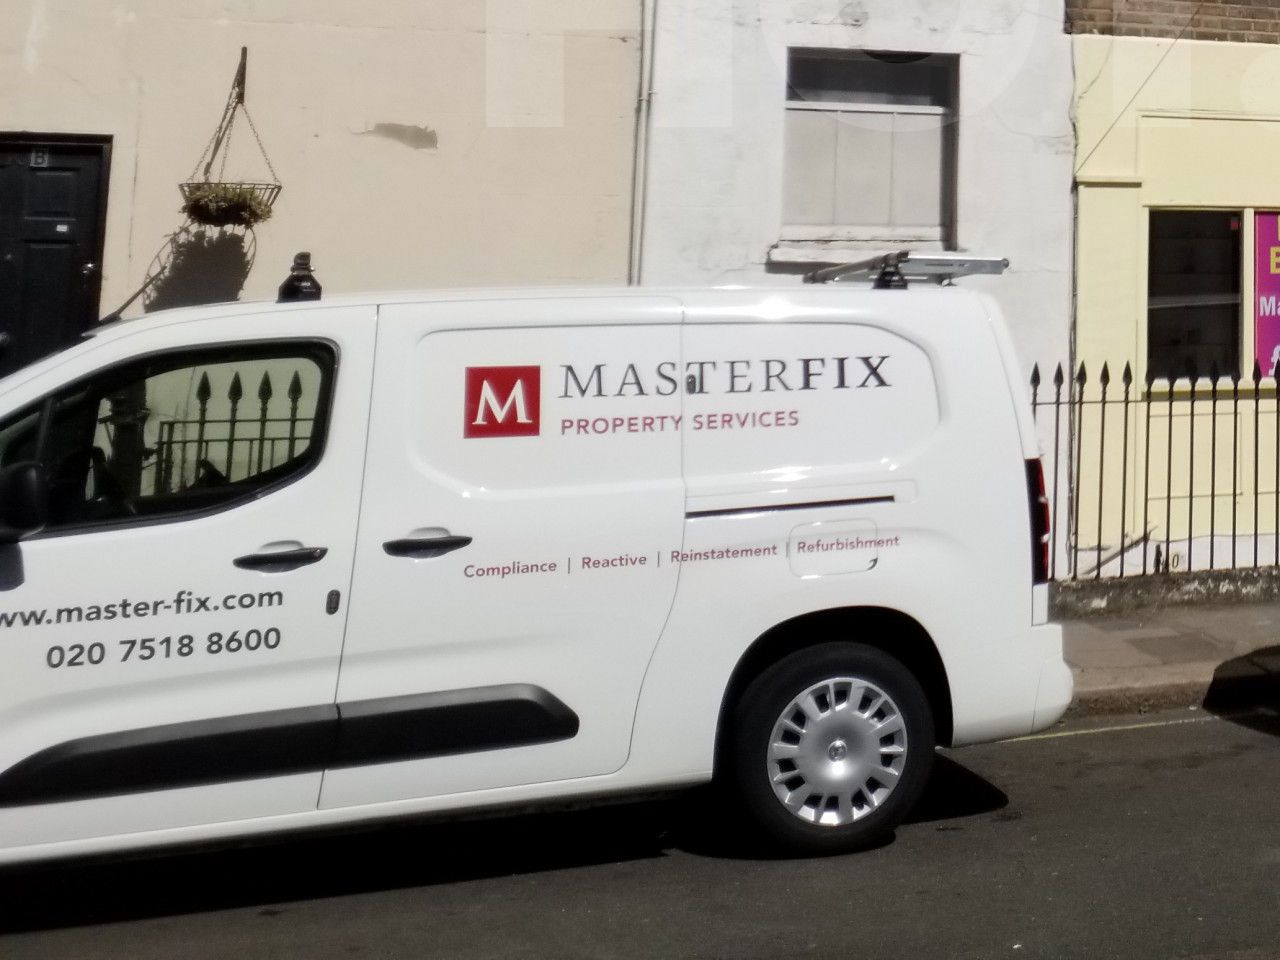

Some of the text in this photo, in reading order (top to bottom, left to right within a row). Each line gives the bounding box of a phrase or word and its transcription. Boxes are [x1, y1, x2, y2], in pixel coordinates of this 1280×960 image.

[471, 355, 892, 425] M MASTERFIX
[560, 410, 800, 436] PROPERTY SERVICES
[463, 535, 901, 579] Compliance Reactive Reinstatement Refurbishment
[46, 626, 282, 669] 020 7518 8600
